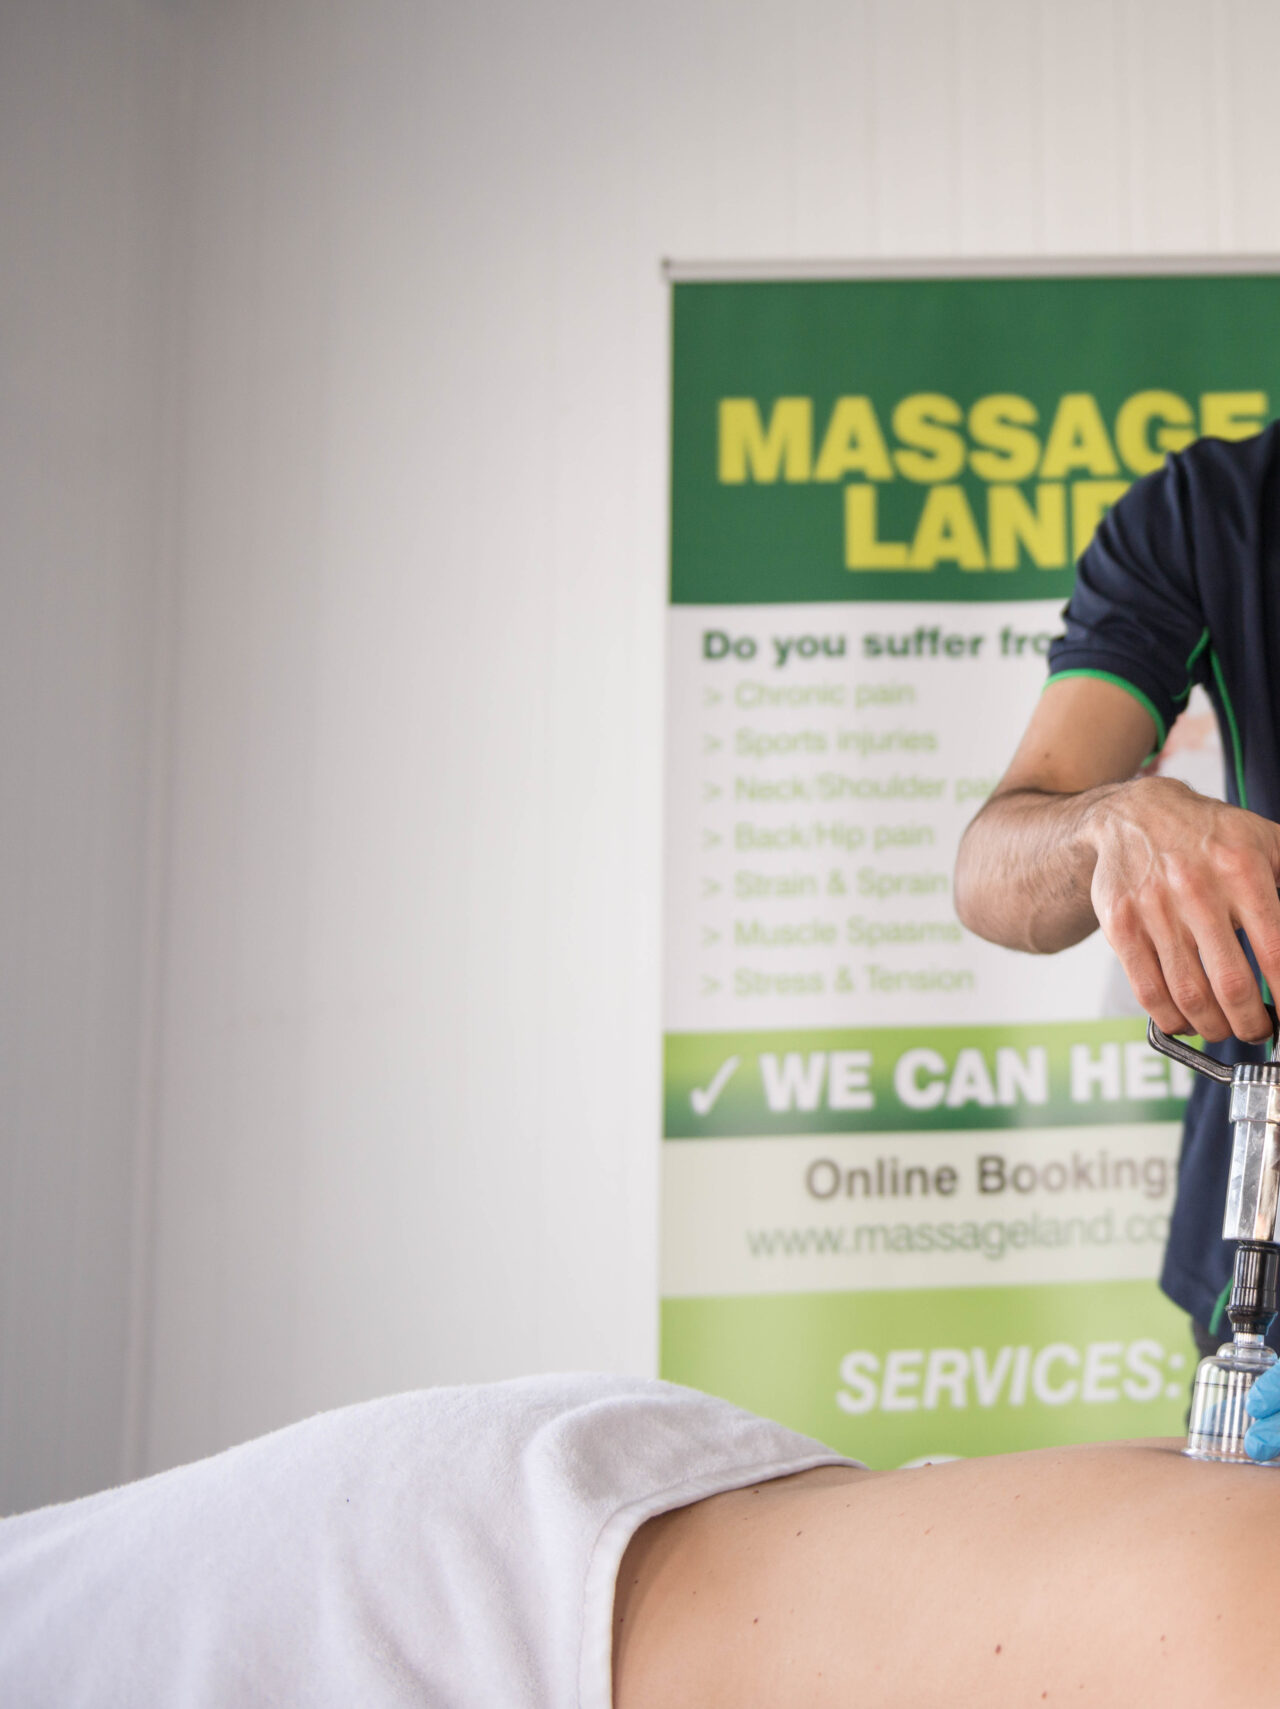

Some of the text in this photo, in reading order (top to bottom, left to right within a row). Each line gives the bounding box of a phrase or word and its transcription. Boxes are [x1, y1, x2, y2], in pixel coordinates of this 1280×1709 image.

[717, 389, 1269, 484] MASSAGE
[703, 625, 1051, 667] Do you suffer fro
[734, 679, 915, 709] Chronic pain
[734, 729, 938, 757] Sports injuries
[955, 774, 1001, 804] pai
[873, 820, 936, 852] pain
[734, 866, 950, 899] Strain & Sprain
[734, 919, 838, 947] Muscle
[734, 963, 975, 996] Stress & Tension
[760, 1041, 1196, 1112] WE CAN HEL
[805, 1149, 1179, 1200] Online Booking
[747, 1211, 1169, 1259] www.massageland.co
[837, 1341, 1185, 1413] SERVICES:
